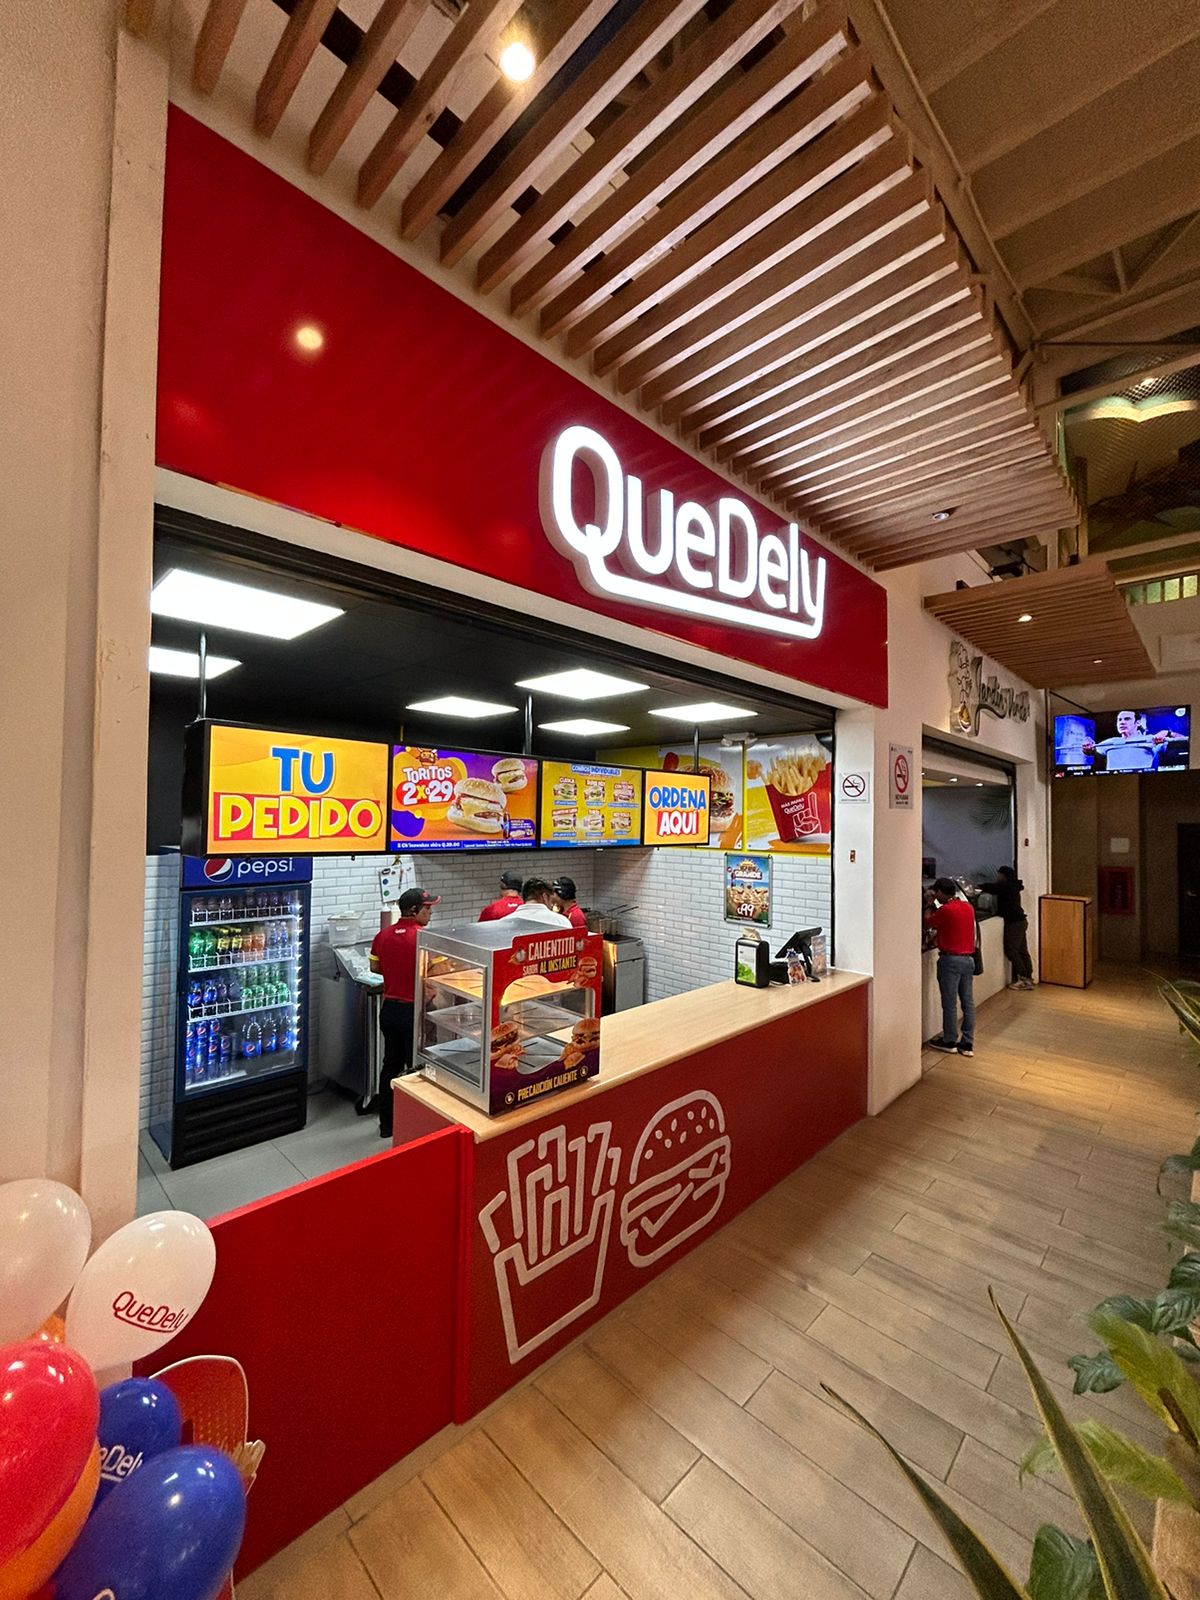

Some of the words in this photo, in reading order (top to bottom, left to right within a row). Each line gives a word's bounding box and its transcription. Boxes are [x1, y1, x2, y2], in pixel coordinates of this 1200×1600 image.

[551, 424, 827, 640] QueDely
[271, 745, 335, 795] TU
[403, 765, 453, 784] TORITOS
[649, 786, 707, 810] ORDENA
[218, 794, 383, 840] PEDIDO
[658, 811, 699, 836] AQUÍ
[237, 857, 293, 878] pepsi
[528, 936, 575, 961] CALIENTITO
[539, 960, 547, 974] AL
[548, 955, 577, 972] INSTANTE
[553, 1069, 578, 1088] CALIENTE
[112, 1290, 189, 1333] QueDely
